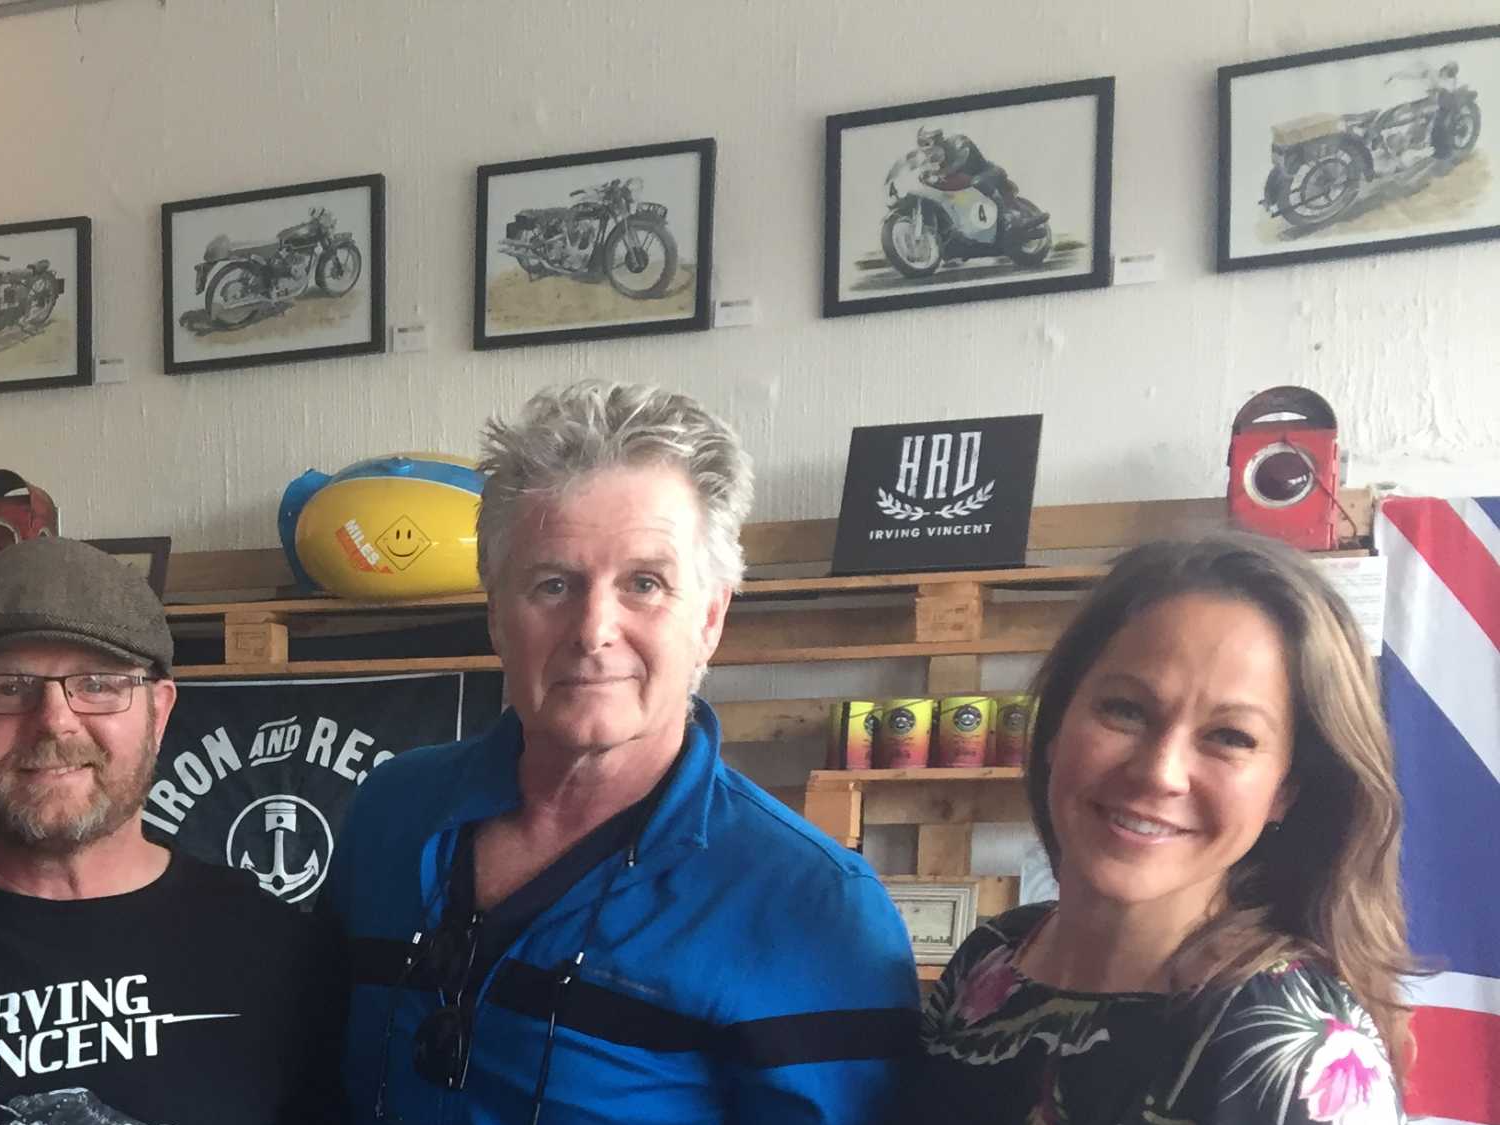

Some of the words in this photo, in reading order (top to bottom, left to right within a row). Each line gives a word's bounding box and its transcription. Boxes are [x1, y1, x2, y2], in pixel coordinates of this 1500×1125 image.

[896, 431, 983, 499] HRD
[869, 527, 921, 540] IRVING
[927, 523, 992, 537] VINCENT
[141, 726, 243, 835] IRON
[249, 724, 301, 760] AND
